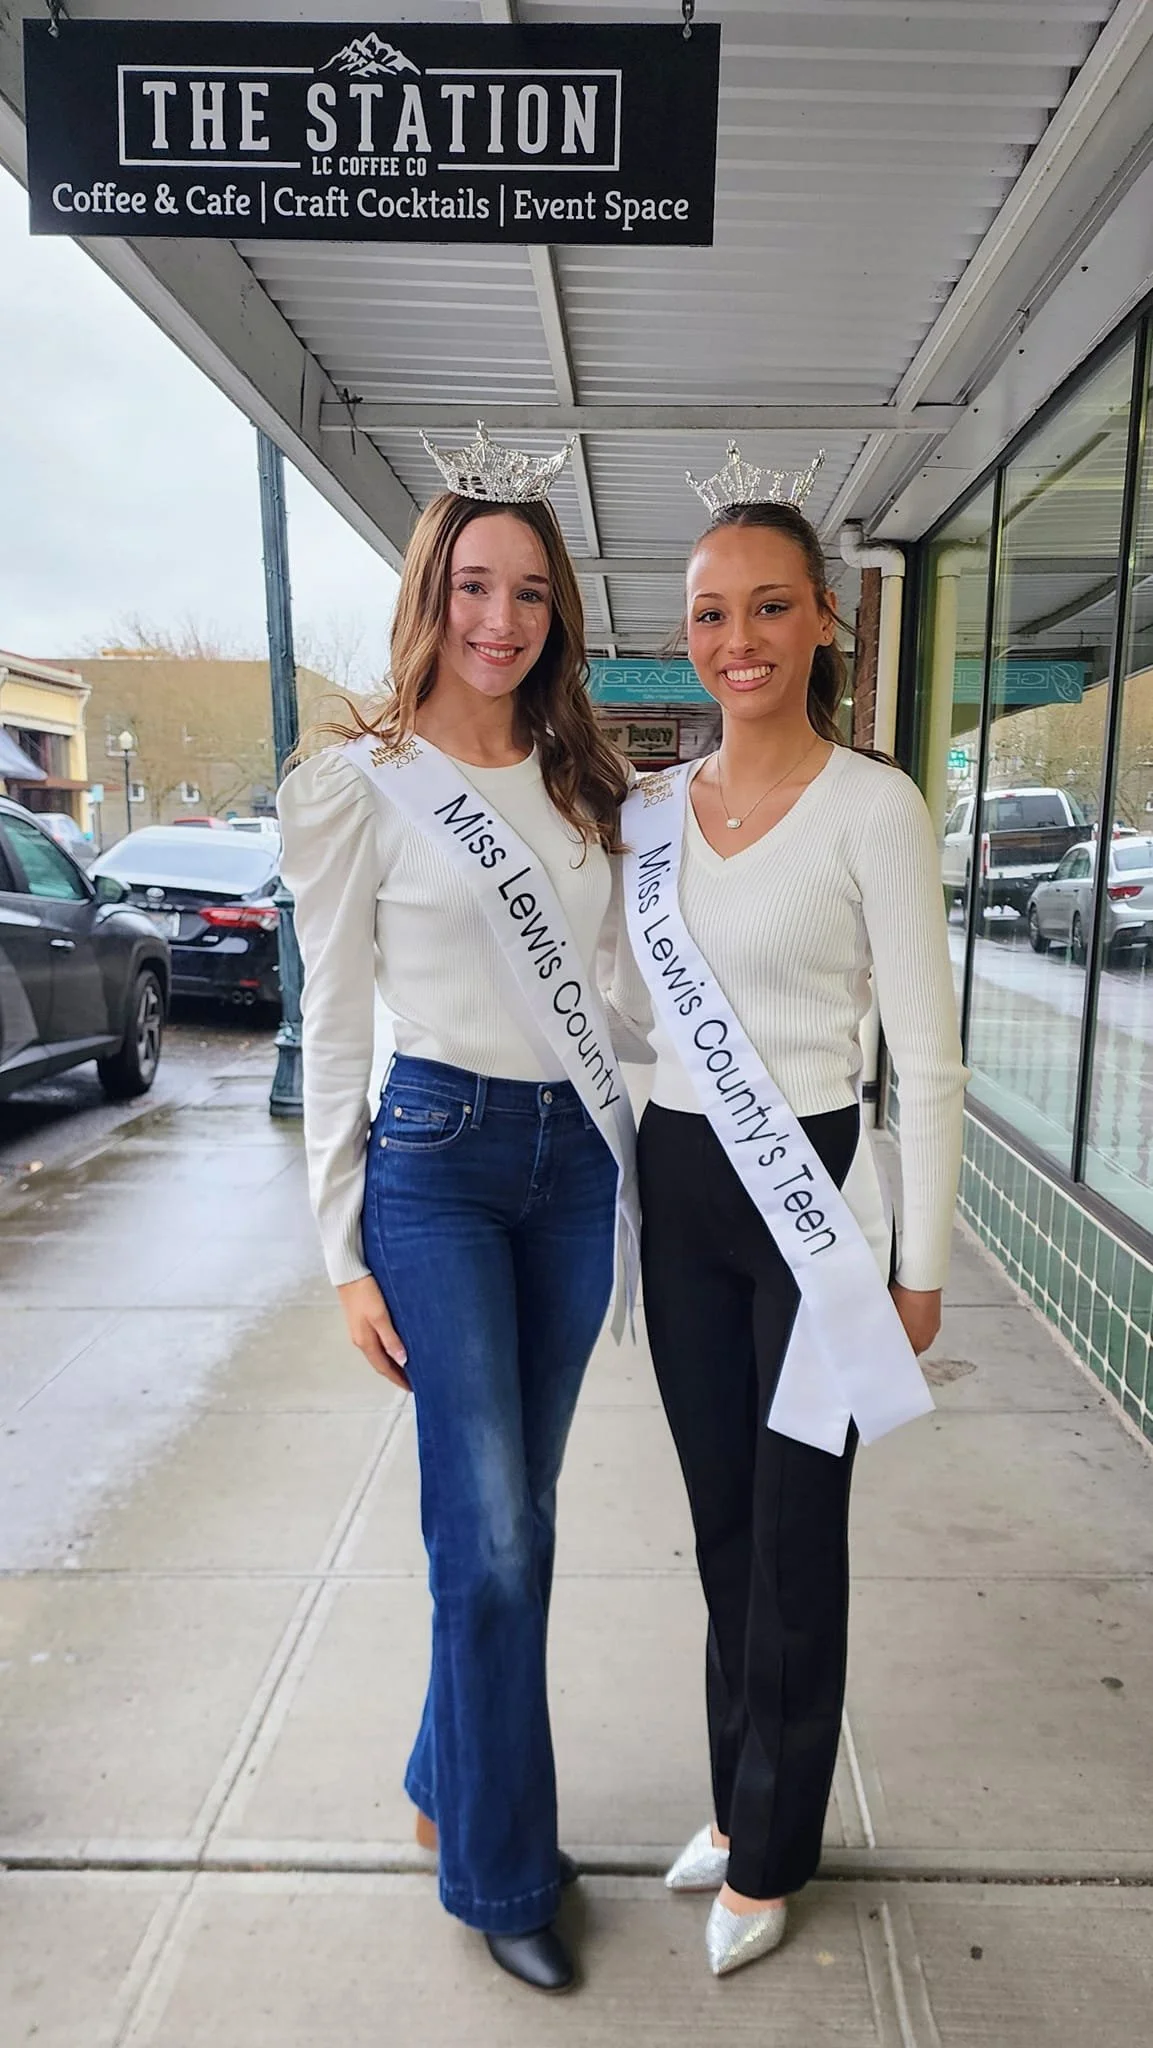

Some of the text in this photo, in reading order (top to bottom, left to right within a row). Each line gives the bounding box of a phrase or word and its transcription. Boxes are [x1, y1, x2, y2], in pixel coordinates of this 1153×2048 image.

[143, 81, 598, 154] THE STATION
[311, 156, 427, 177] LC COFFEE CO
[52, 182, 689, 231] Coffee & Cafe Craft Cocktails Event Space
[391, 746, 423, 769] 2024
[643, 788, 674, 808] 2024
[433, 792, 621, 1110] Miss Lewis County
[638, 841, 838, 1256] Miss Lewis County's Teen
